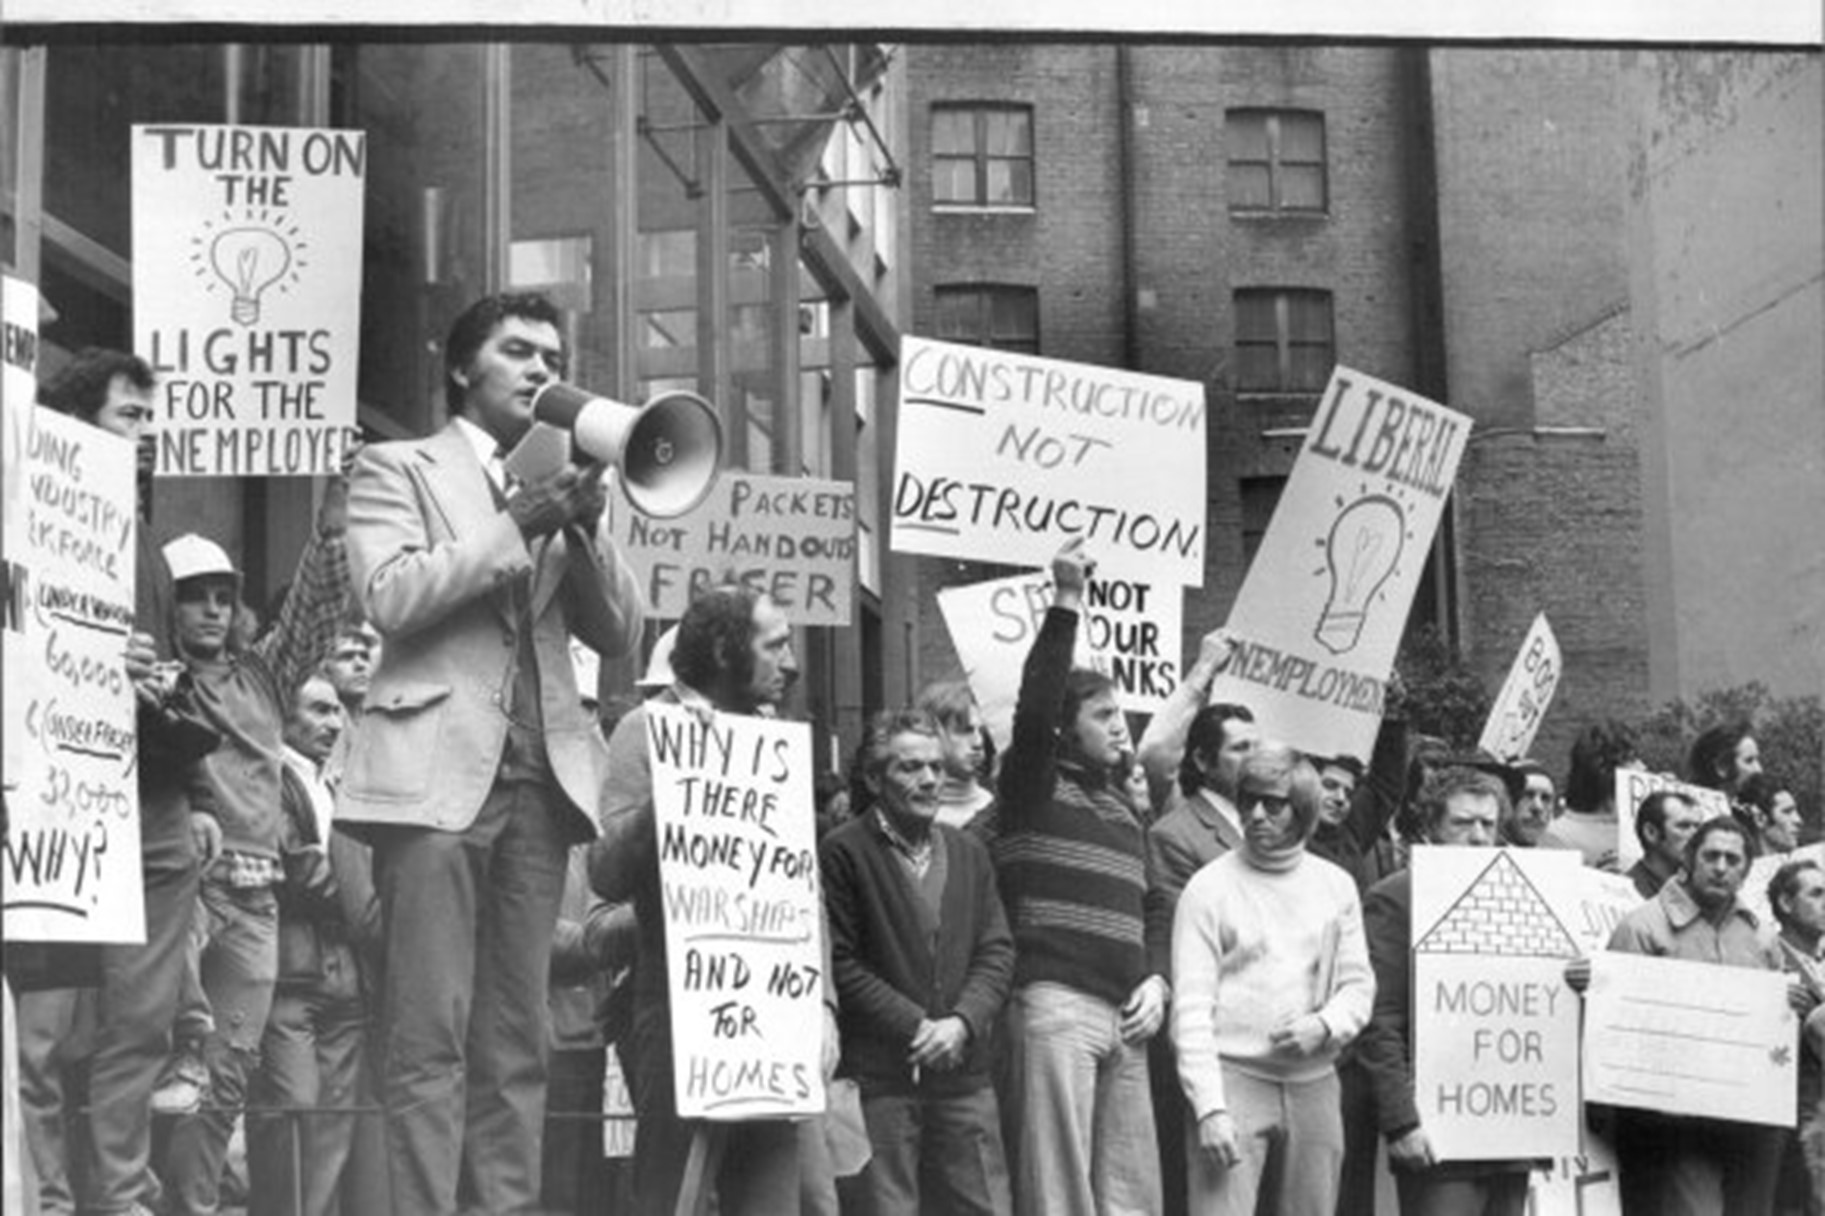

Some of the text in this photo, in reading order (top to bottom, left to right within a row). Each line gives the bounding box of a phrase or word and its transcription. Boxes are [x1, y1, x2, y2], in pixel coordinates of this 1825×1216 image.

[143, 127, 366, 178] TURN ON
[215, 174, 293, 206] THE
[150, 328, 332, 376] LIGHTS
[166, 380, 326, 420] FOR THE
[904, 346, 1206, 432] CONSTRUCTION
[996, 423, 1114, 470] NOT
[730, 480, 854, 520] PACKETS
[628, 514, 690, 552] NOT
[1088, 579, 1151, 613] NOT
[1111, 655, 1176, 700] NKS
[649, 711, 789, 784] WHY IS
[675, 775, 780, 838] THERE
[661, 822, 815, 894] MONEY FOR
[683, 947, 820, 1000] AND NOT
[709, 1001, 763, 1041] FOR
[1434, 980, 1562, 1019] MONEY
[1473, 1029, 1544, 1064] FOR
[686, 1055, 810, 1100] HOMES
[1437, 1082, 1558, 1117] HOMES
